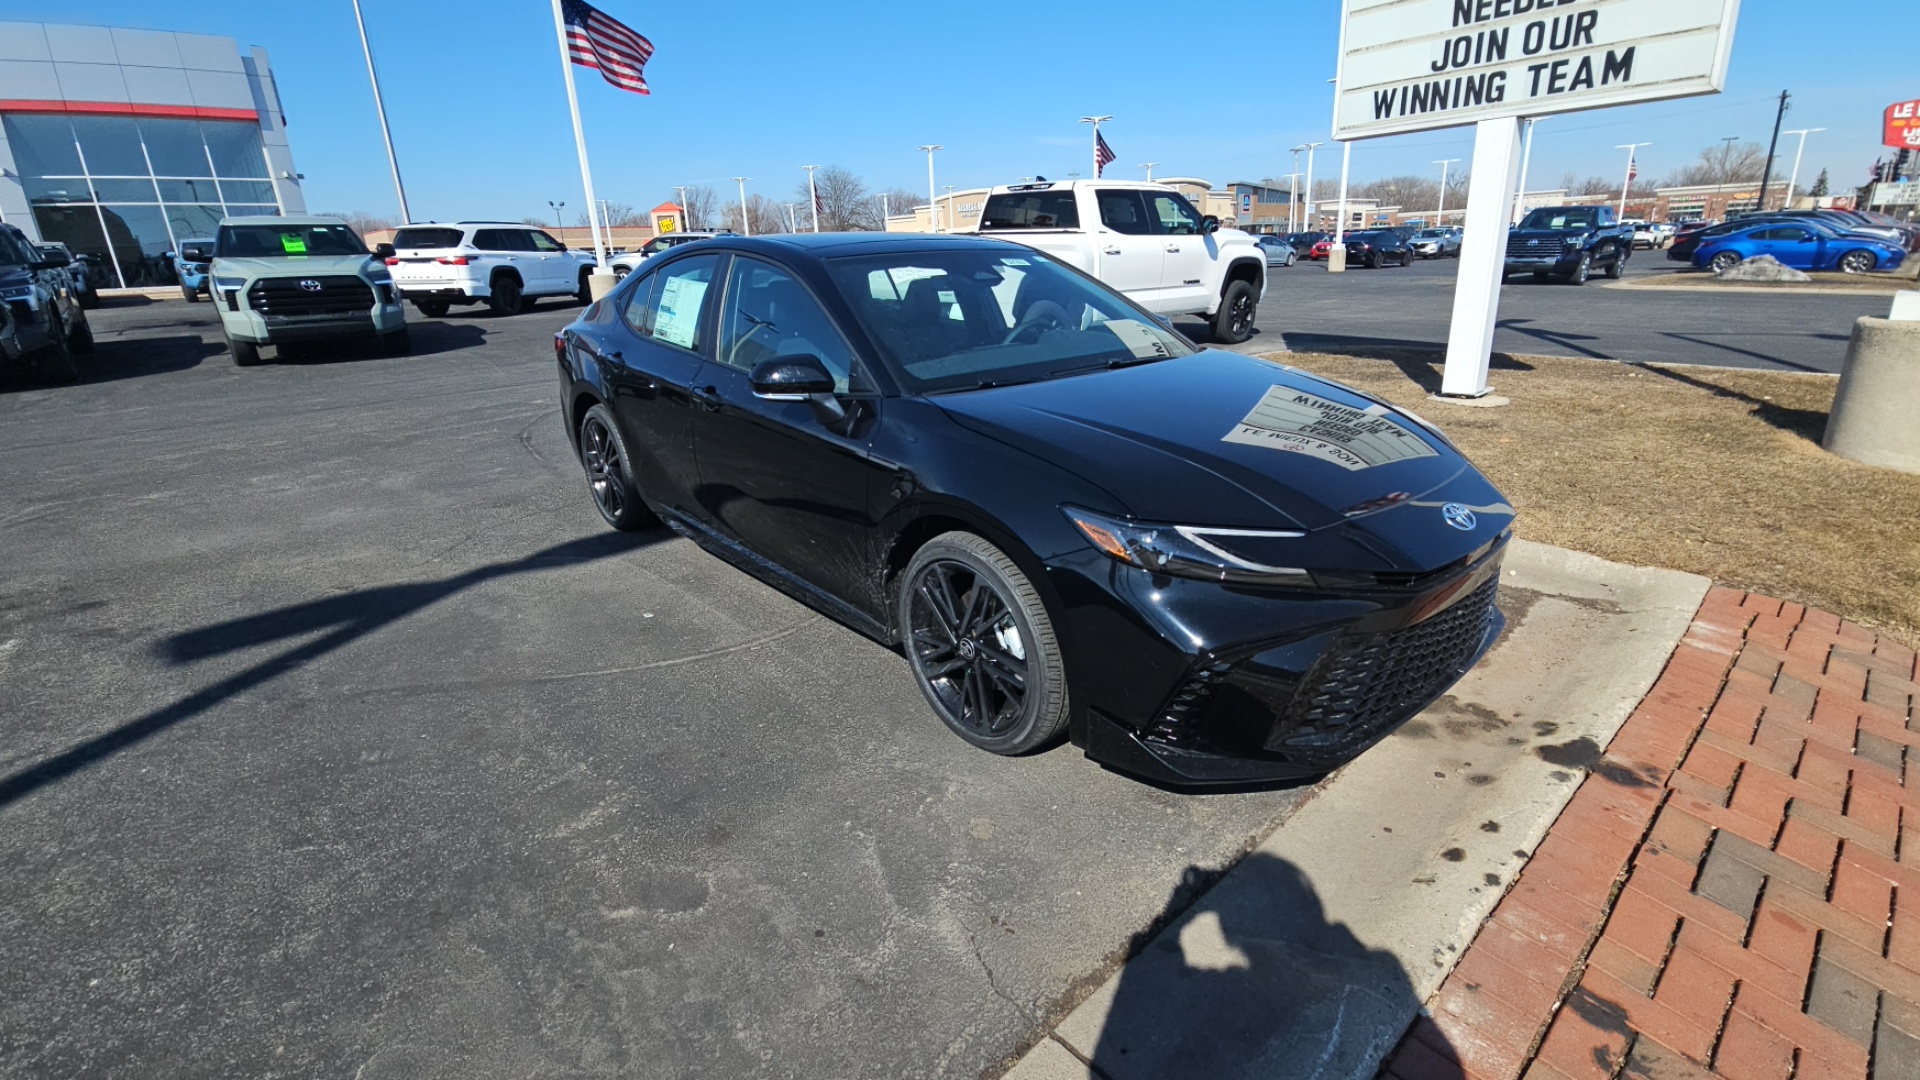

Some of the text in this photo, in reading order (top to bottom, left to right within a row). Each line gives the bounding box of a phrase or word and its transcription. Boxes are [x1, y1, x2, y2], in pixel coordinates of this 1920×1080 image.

[1452, 0, 1576, 27] NEE
[1432, 9, 1598, 72] JOIN OUR
[1374, 46, 1636, 119] WINNING TEAM
[1893, 102, 1915, 118] LE
